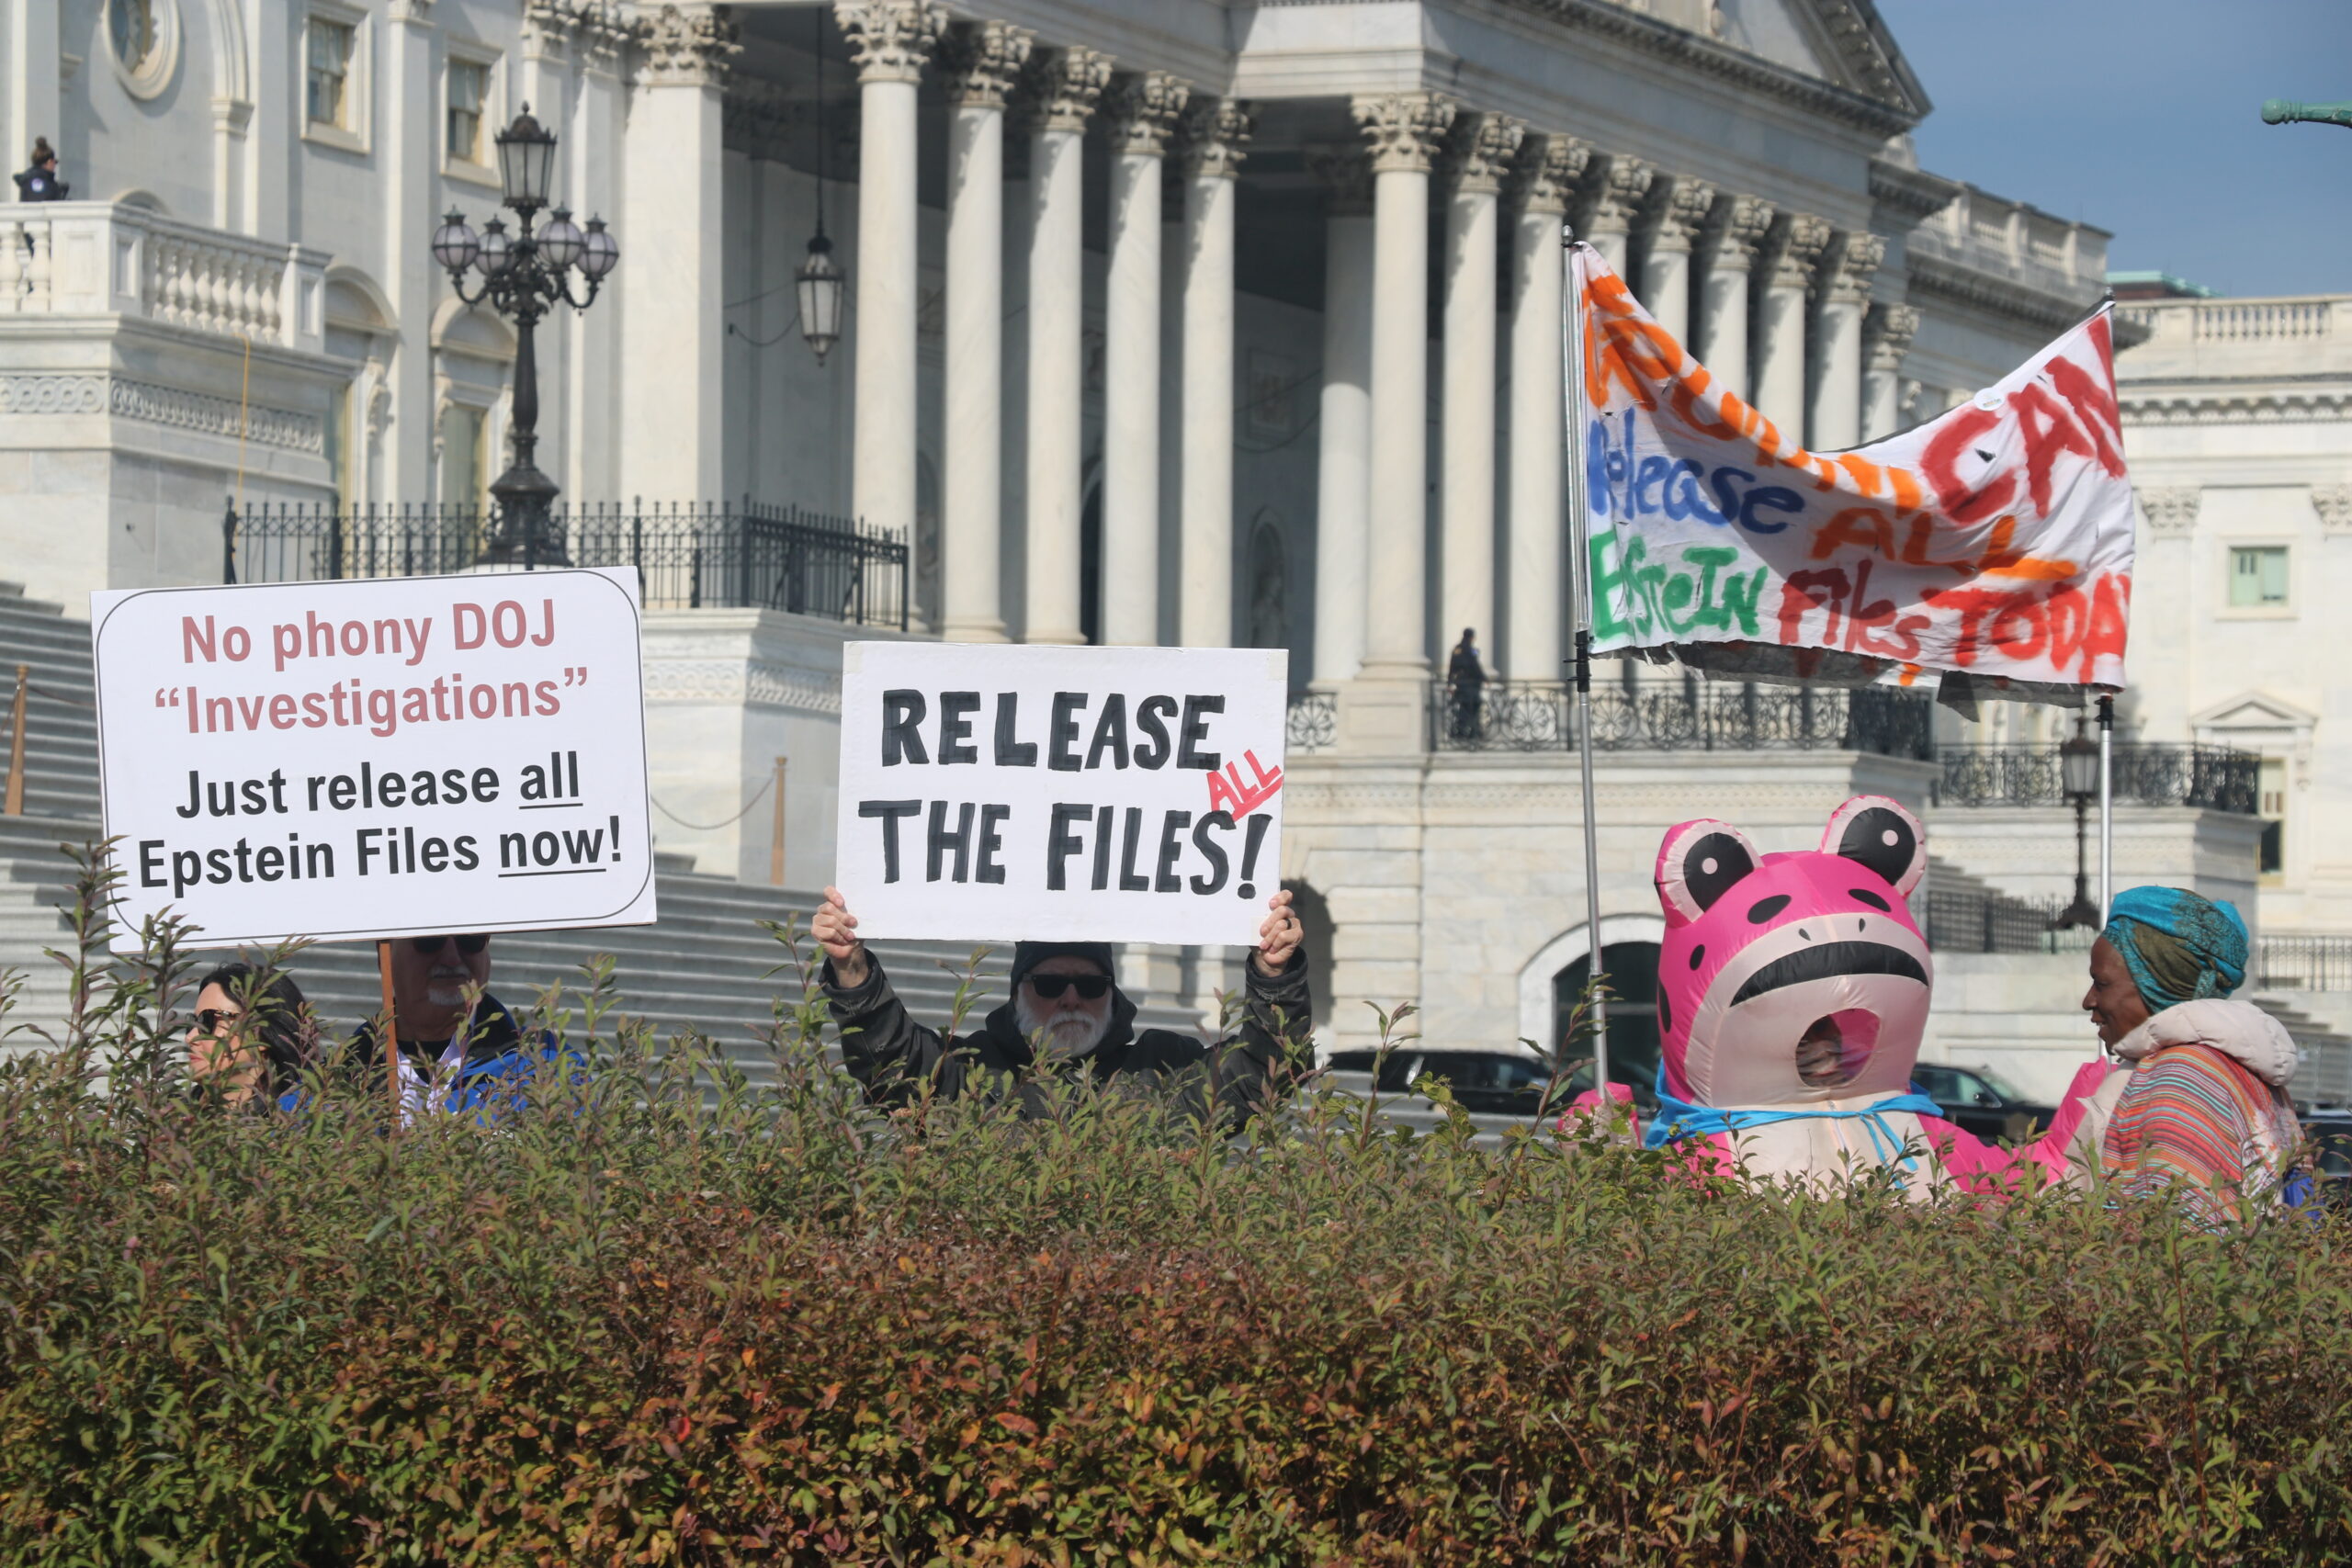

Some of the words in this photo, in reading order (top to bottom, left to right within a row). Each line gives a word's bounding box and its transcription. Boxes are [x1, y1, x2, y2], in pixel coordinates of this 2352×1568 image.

[182, 615, 252, 663] No
[273, 611, 432, 671] phony
[453, 598, 556, 650] DOJ
[1920, 571, 2131, 683] TODA
[155, 667, 588, 737] “Investigations”
[882, 689, 1225, 772] RELEASE
[176, 769, 288, 818] Just
[308, 762, 499, 811] release
[519, 751, 582, 809] all
[1206, 750, 1283, 821] ALL
[140, 833, 334, 898] Epstein
[356, 827, 479, 875] Files
[498, 816, 620, 877] now!
[858, 800, 1010, 885] THE
[1047, 803, 1272, 899] FILES!
